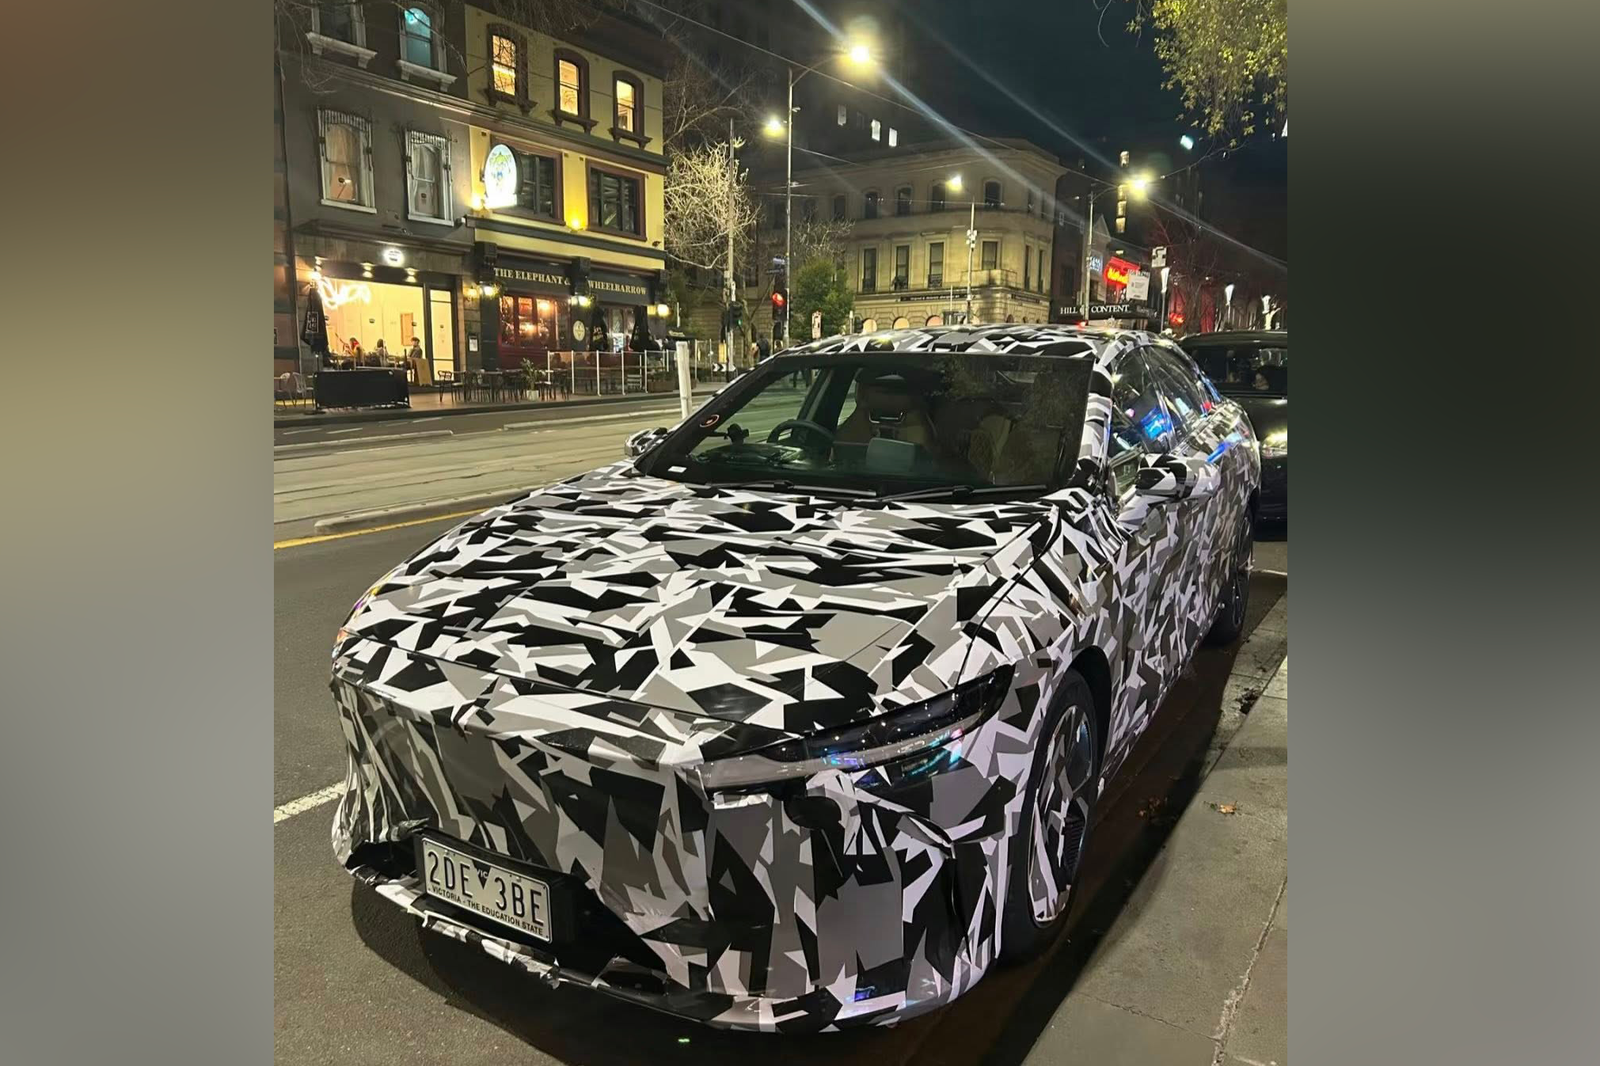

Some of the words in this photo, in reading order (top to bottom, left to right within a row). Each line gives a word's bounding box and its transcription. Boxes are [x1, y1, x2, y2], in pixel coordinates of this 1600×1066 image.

[493, 267, 514, 279] THE
[515, 270, 563, 285] ELEPHANT
[587, 280, 647, 295] WHEELBARROW
[1060, 306, 1078, 314] HILL
[1091, 305, 1130, 313] CONTENT
[477, 868, 489, 879] VIC
[428, 851, 473, 898] 2DE
[494, 877, 544, 926] 3BE
[432, 885, 462, 903] VICTORIA
[468, 899, 480, 910] THE
[481, 905, 520, 926] EDUCATION
[521, 921, 543, 936] STATE
